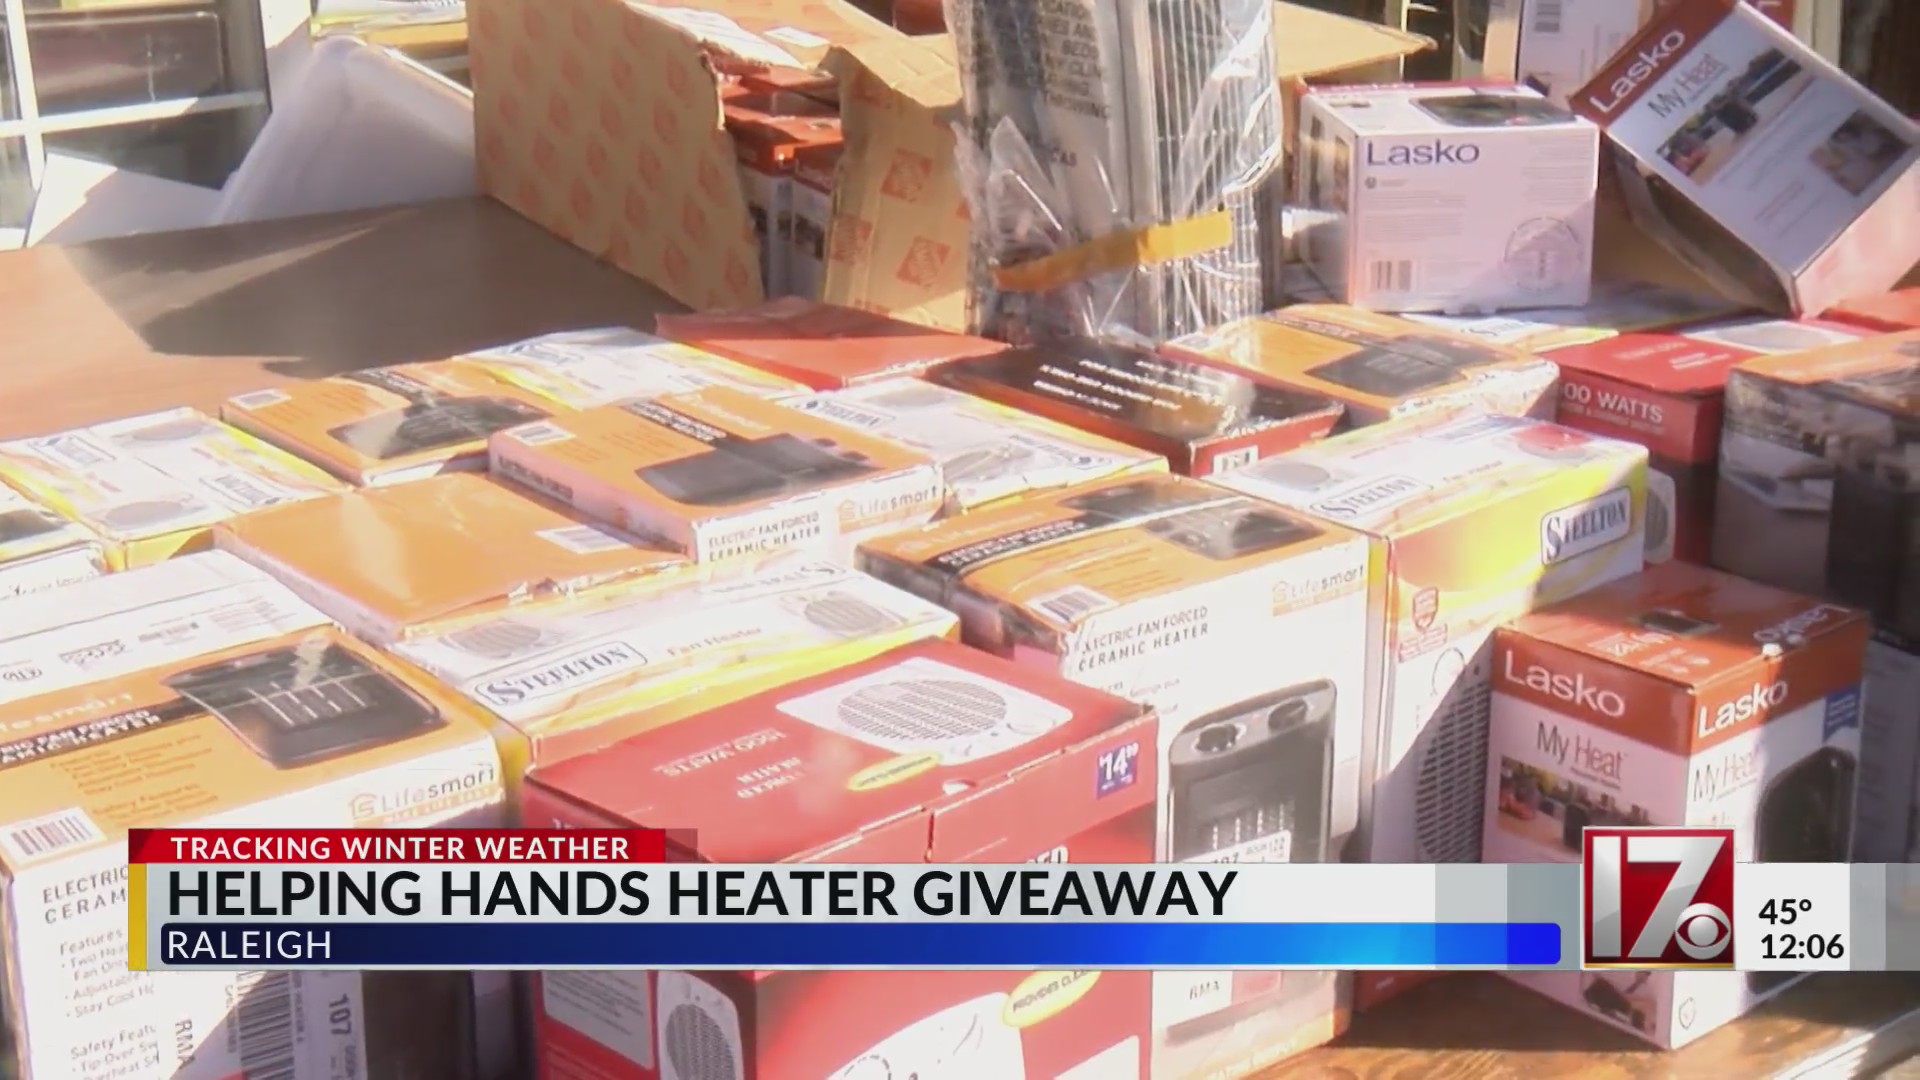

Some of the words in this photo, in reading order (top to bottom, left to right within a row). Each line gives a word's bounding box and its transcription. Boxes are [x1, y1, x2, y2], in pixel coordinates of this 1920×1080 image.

[1589, 30, 1685, 113] Lasko
[1647, 88, 1687, 118] My
[1367, 139, 1480, 166] Lasko
[1597, 391, 1664, 424] WATTS
[773, 525, 821, 545] HEATER
[1546, 499, 1627, 561] STEELTON
[1137, 618, 1161, 637] FAN
[1163, 605, 1209, 629] FORCED
[1078, 641, 1147, 673] CERAMIC
[1153, 622, 1209, 649] HEATER
[486, 645, 630, 705] STEELTON
[1504, 650, 1626, 719] Lasko
[1697, 679, 1788, 737] Lasko
[1536, 720, 1570, 765] My
[1575, 735, 1623, 781] Heat
[381, 767, 495, 812] Lifesmart
[1693, 763, 1721, 803] My
[43, 864, 128, 904] ELECTRIC
[59, 928, 123, 956] Features
[71, 954, 97, 969] Two
[73, 968, 98, 982] Fan
[74, 1001, 103, 1018] Stay
[107, 989, 135, 1007] Cool
[328, 993, 352, 1036] 107
[70, 1037, 115, 1060] Safety
[174, 1019, 196, 1071] RMA
